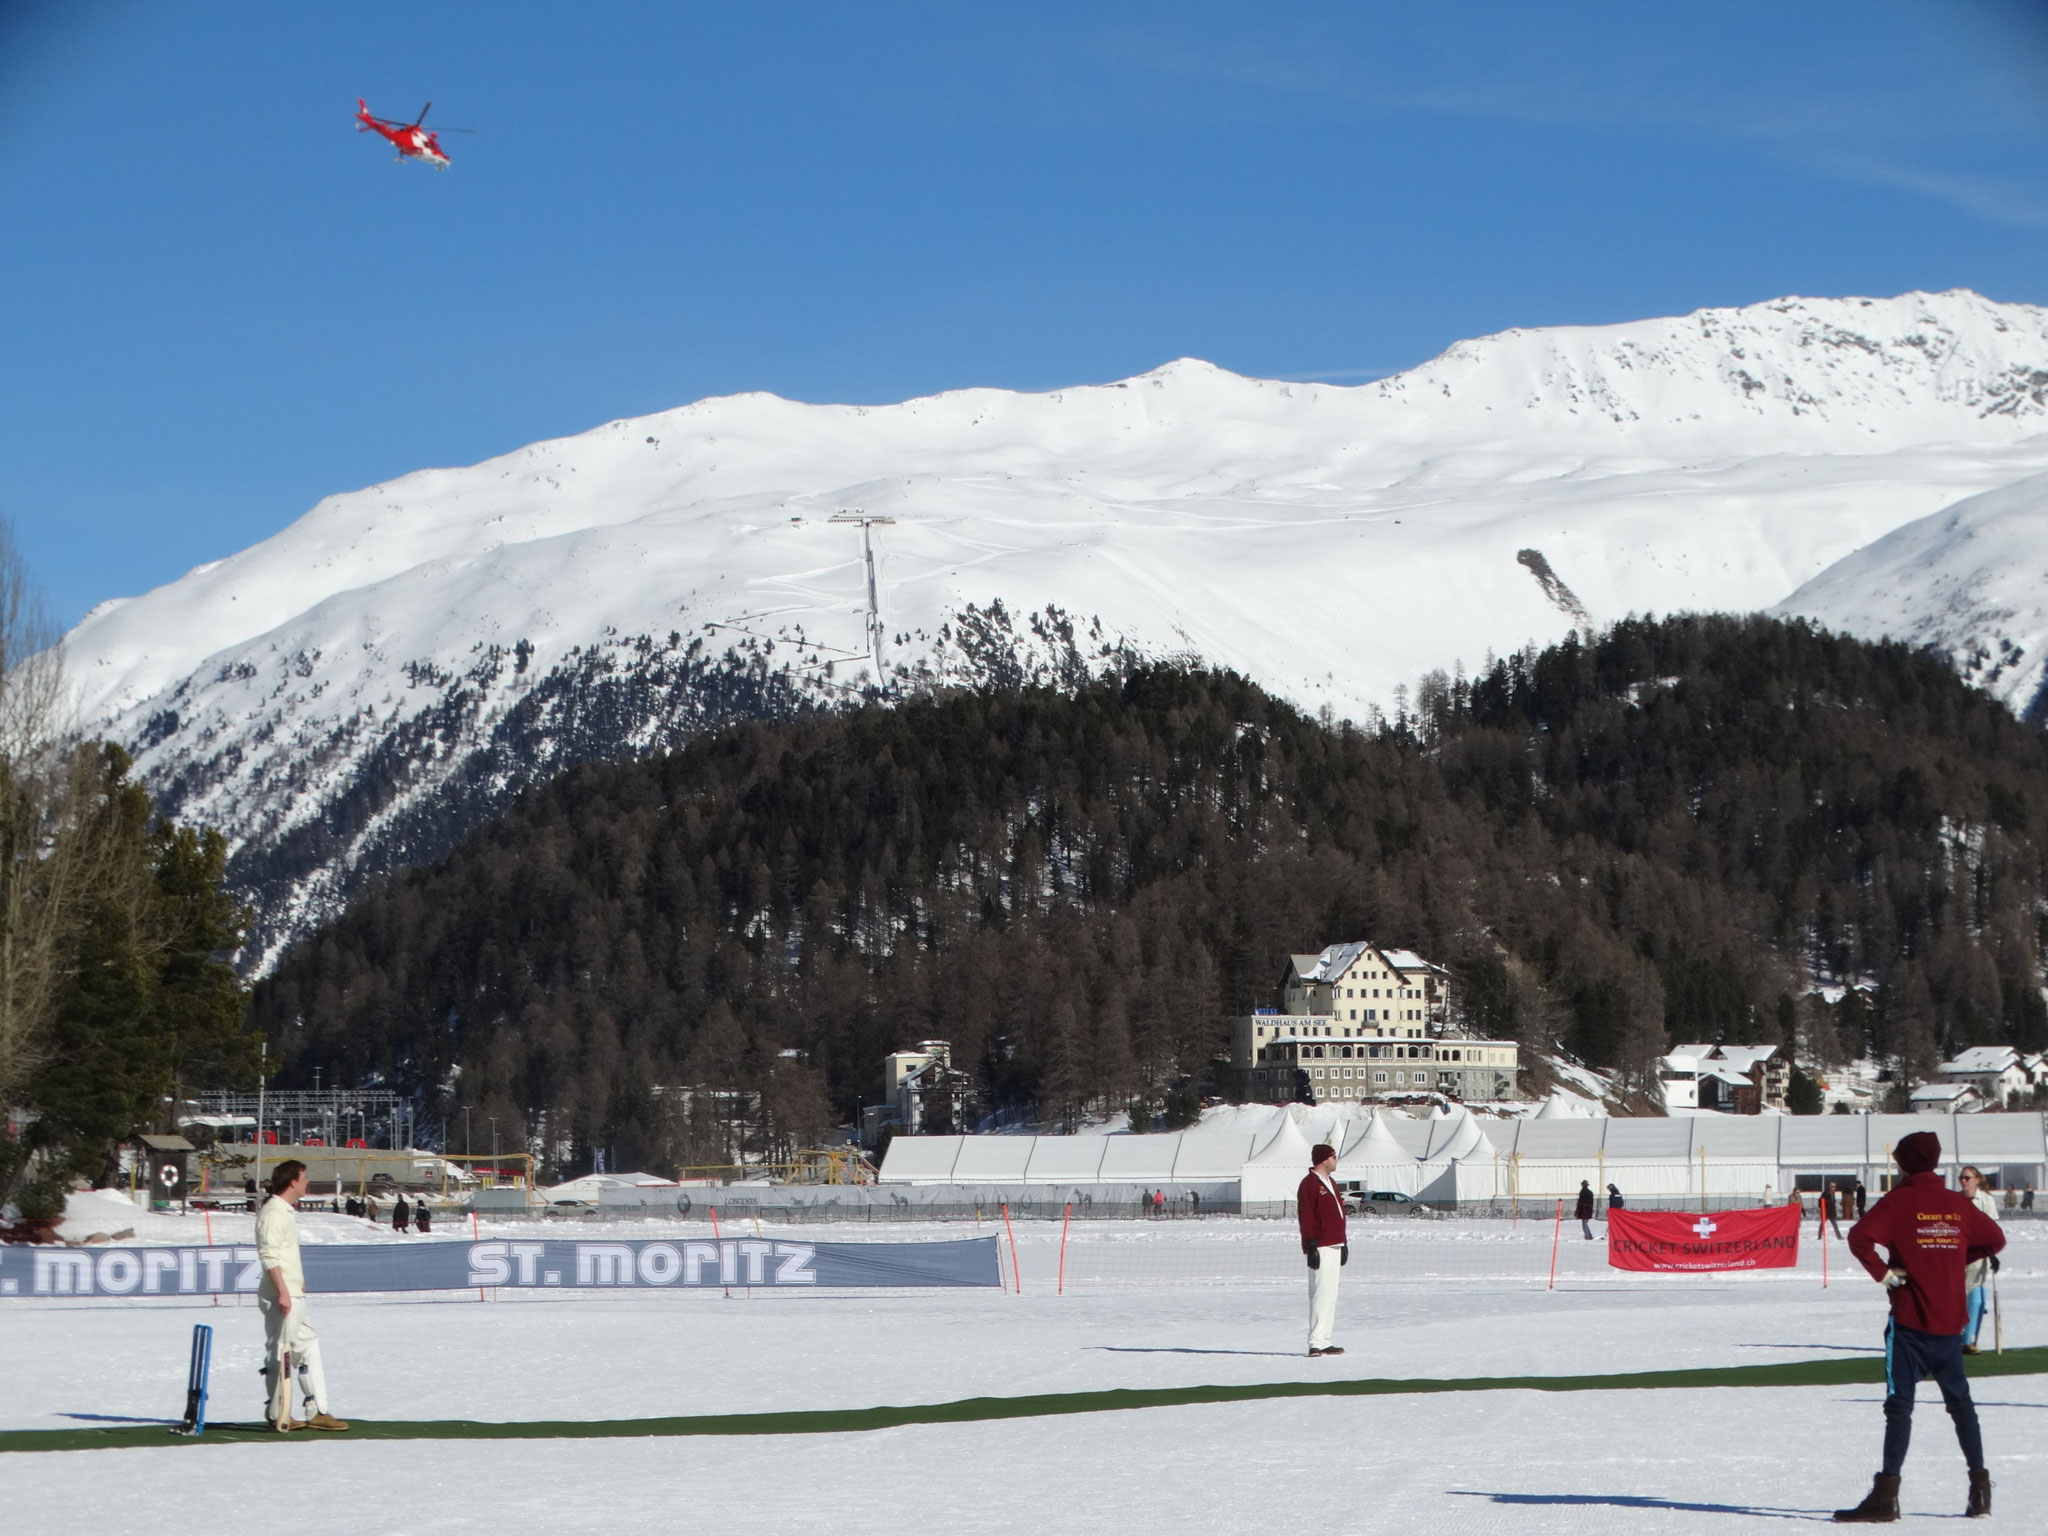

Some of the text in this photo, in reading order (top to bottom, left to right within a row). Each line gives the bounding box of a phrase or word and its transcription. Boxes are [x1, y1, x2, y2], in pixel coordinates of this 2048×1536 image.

[1255, 1019, 1328, 1027] WALDHAUS AM SEE
[725, 1197, 759, 1206] LONGINES
[1613, 1235, 1796, 1255] CRICKET SWITZERLAND
[468, 1241, 816, 1286] ST. MORITZ
[1653, 1258, 1756, 1271] www.cricketswitzerland.ch
